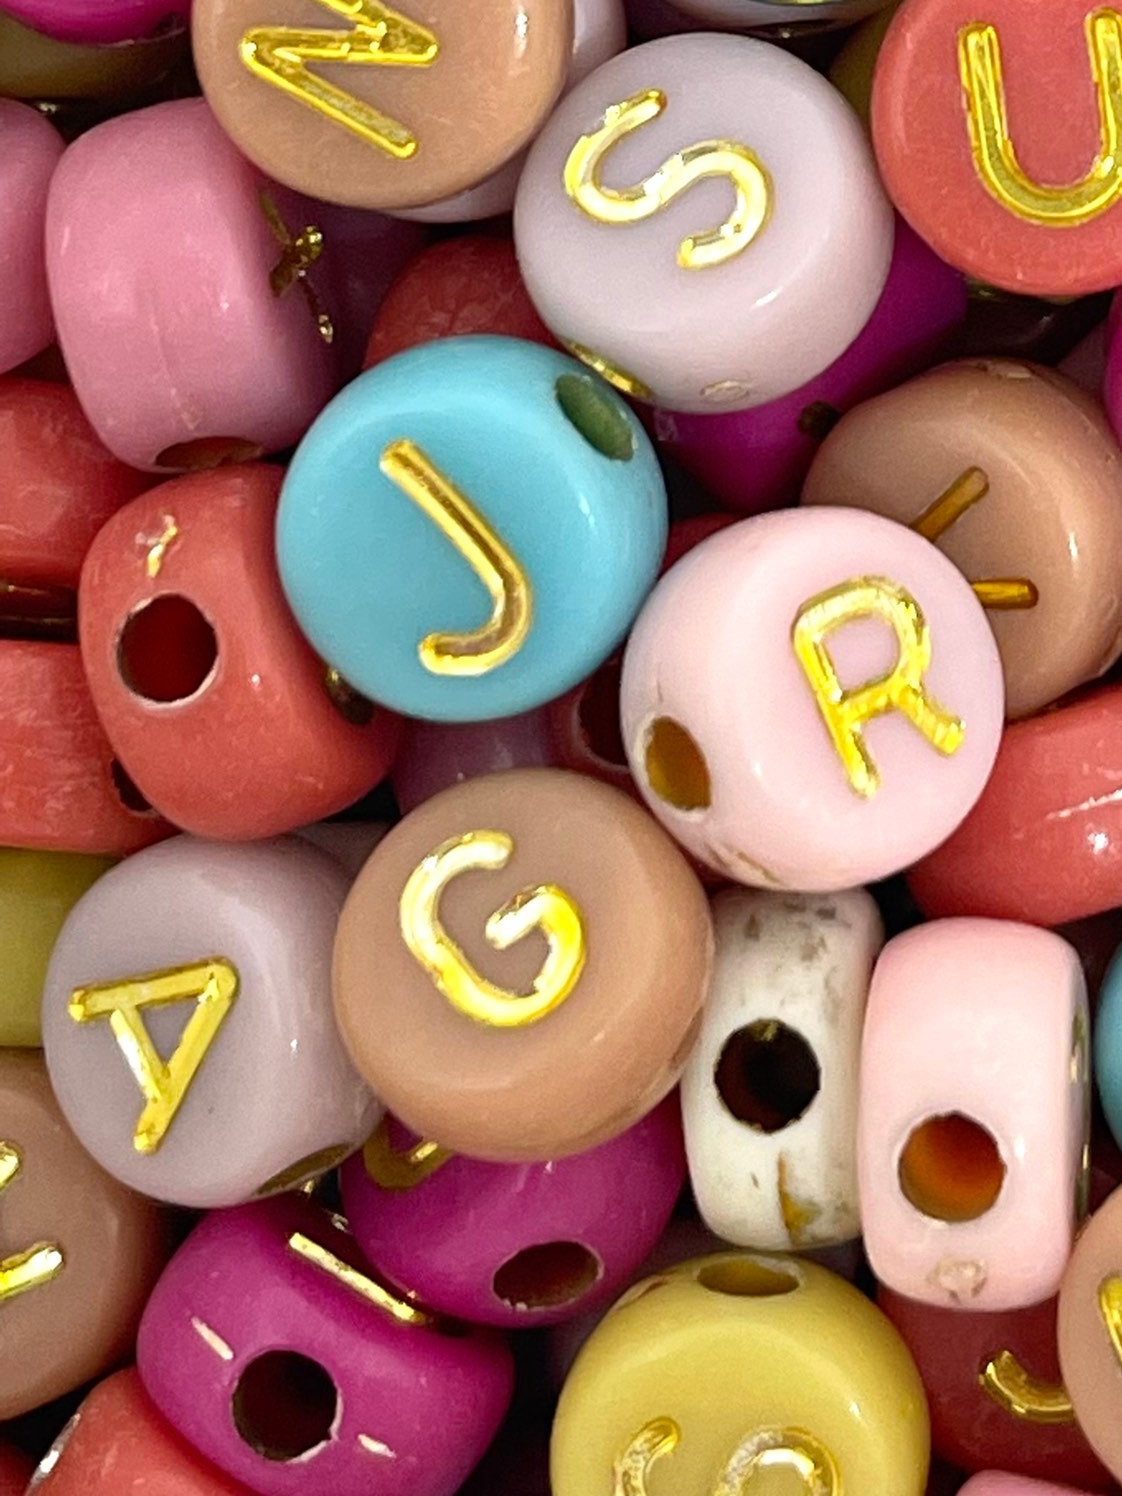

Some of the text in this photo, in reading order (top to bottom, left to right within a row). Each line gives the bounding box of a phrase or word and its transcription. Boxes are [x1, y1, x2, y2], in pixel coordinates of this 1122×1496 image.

[564, 88, 774, 271] S
[380, 439, 533, 677] J
[791, 575, 966, 800] R
[400, 829, 588, 1029] G
[67, 955, 240, 1156] A
